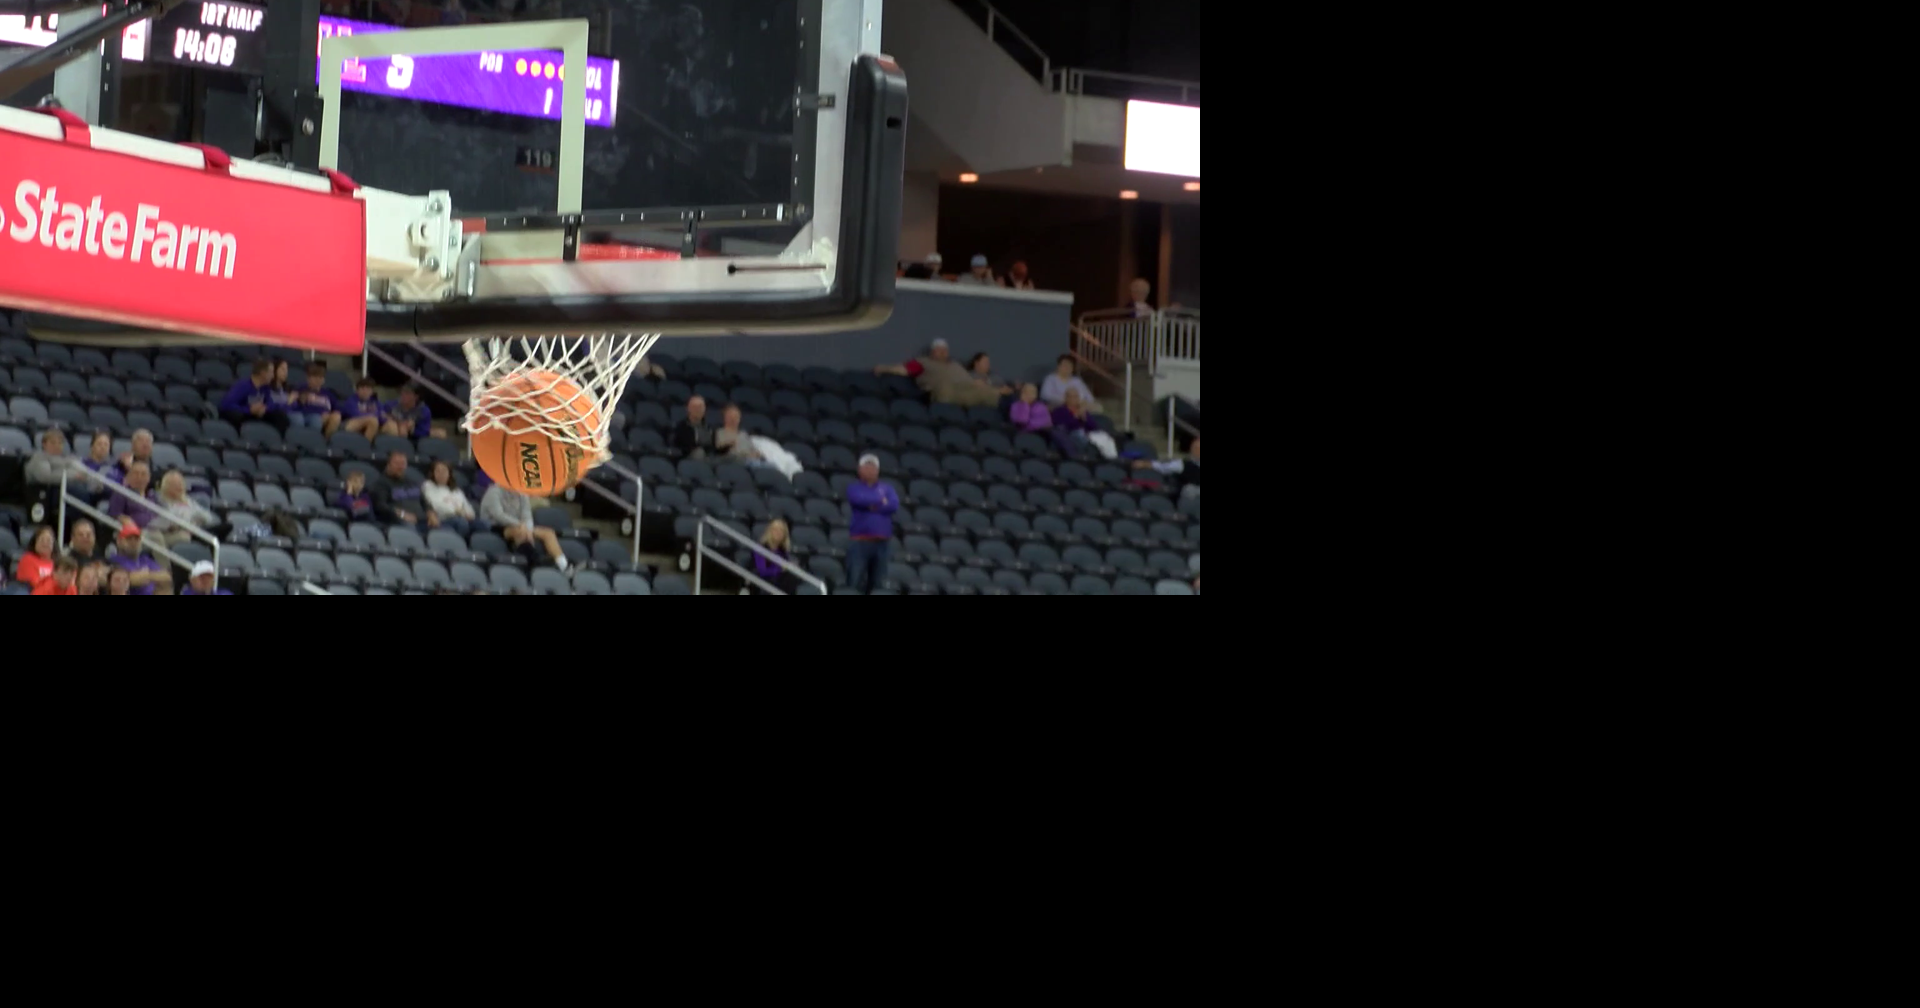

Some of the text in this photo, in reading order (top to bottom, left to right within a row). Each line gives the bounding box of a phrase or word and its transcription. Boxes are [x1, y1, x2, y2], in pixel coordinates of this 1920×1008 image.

[226, 5, 263, 32] HALF
[10, 178, 238, 280] State Farm
